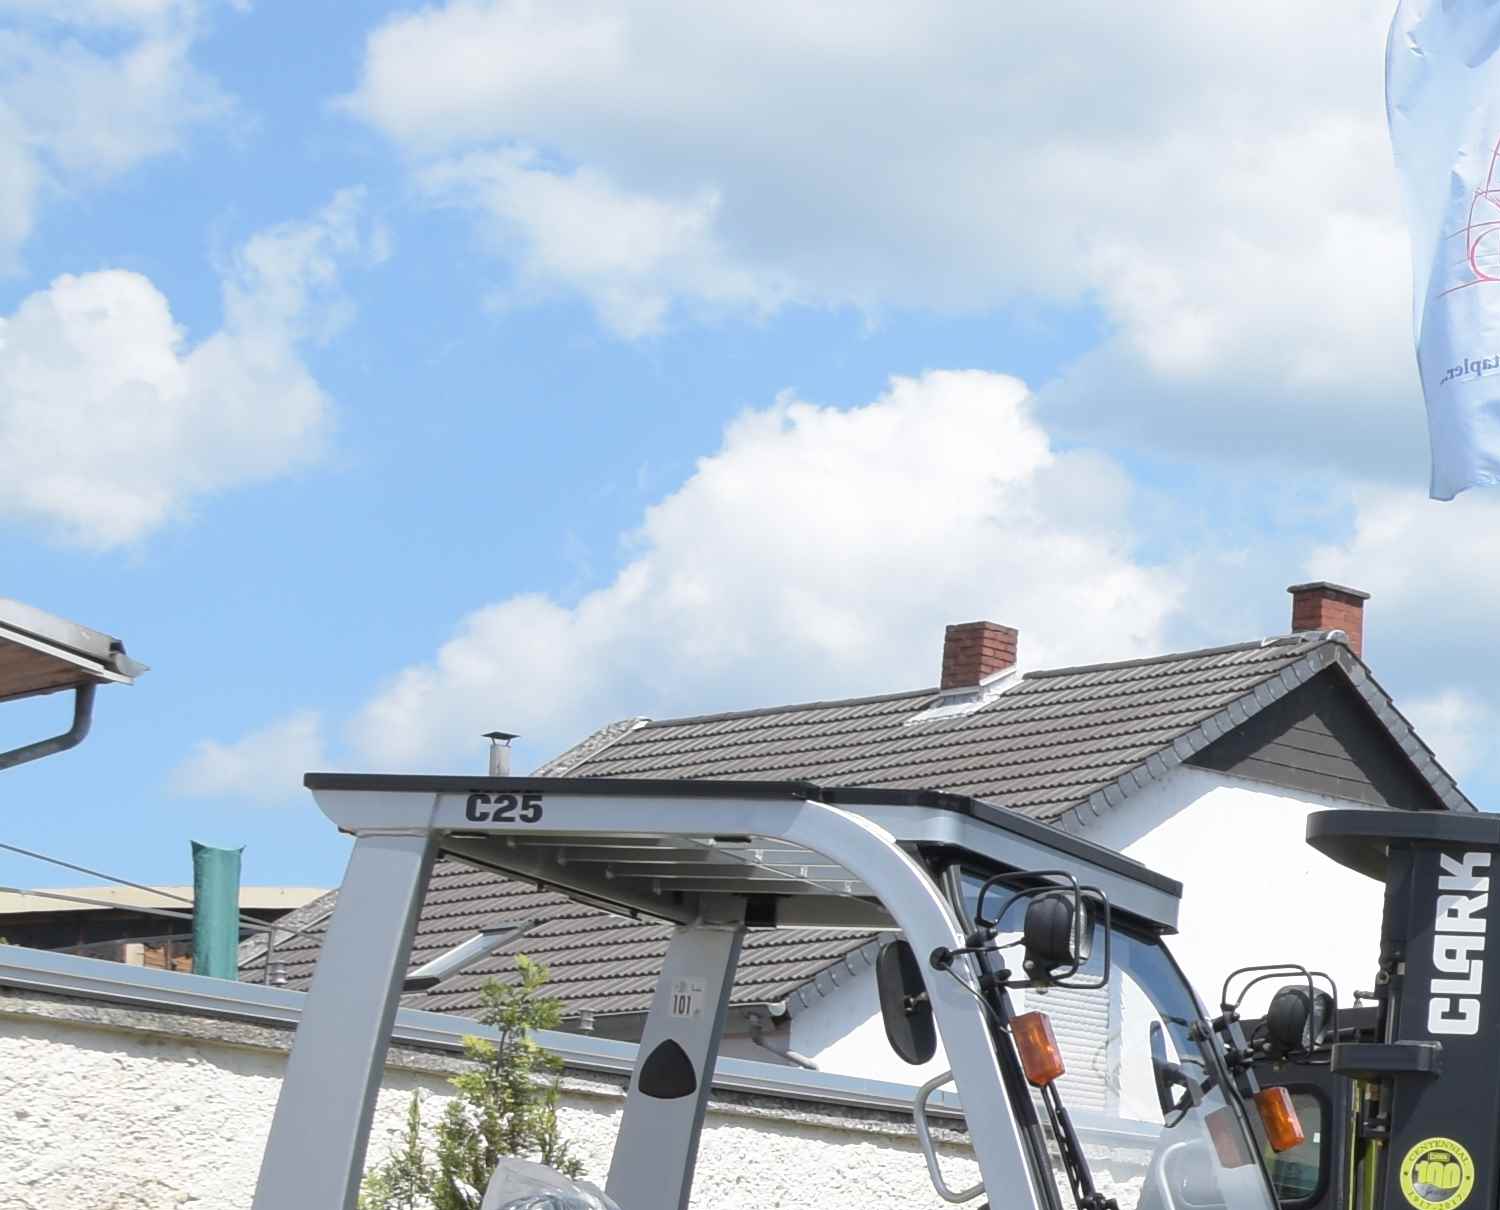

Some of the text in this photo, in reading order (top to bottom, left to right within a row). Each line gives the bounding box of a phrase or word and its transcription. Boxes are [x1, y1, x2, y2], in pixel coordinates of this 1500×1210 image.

[465, 790, 544, 824] C25
[1428, 852, 1491, 1035] CLARK
[1415, 1160, 1461, 1189] 100
